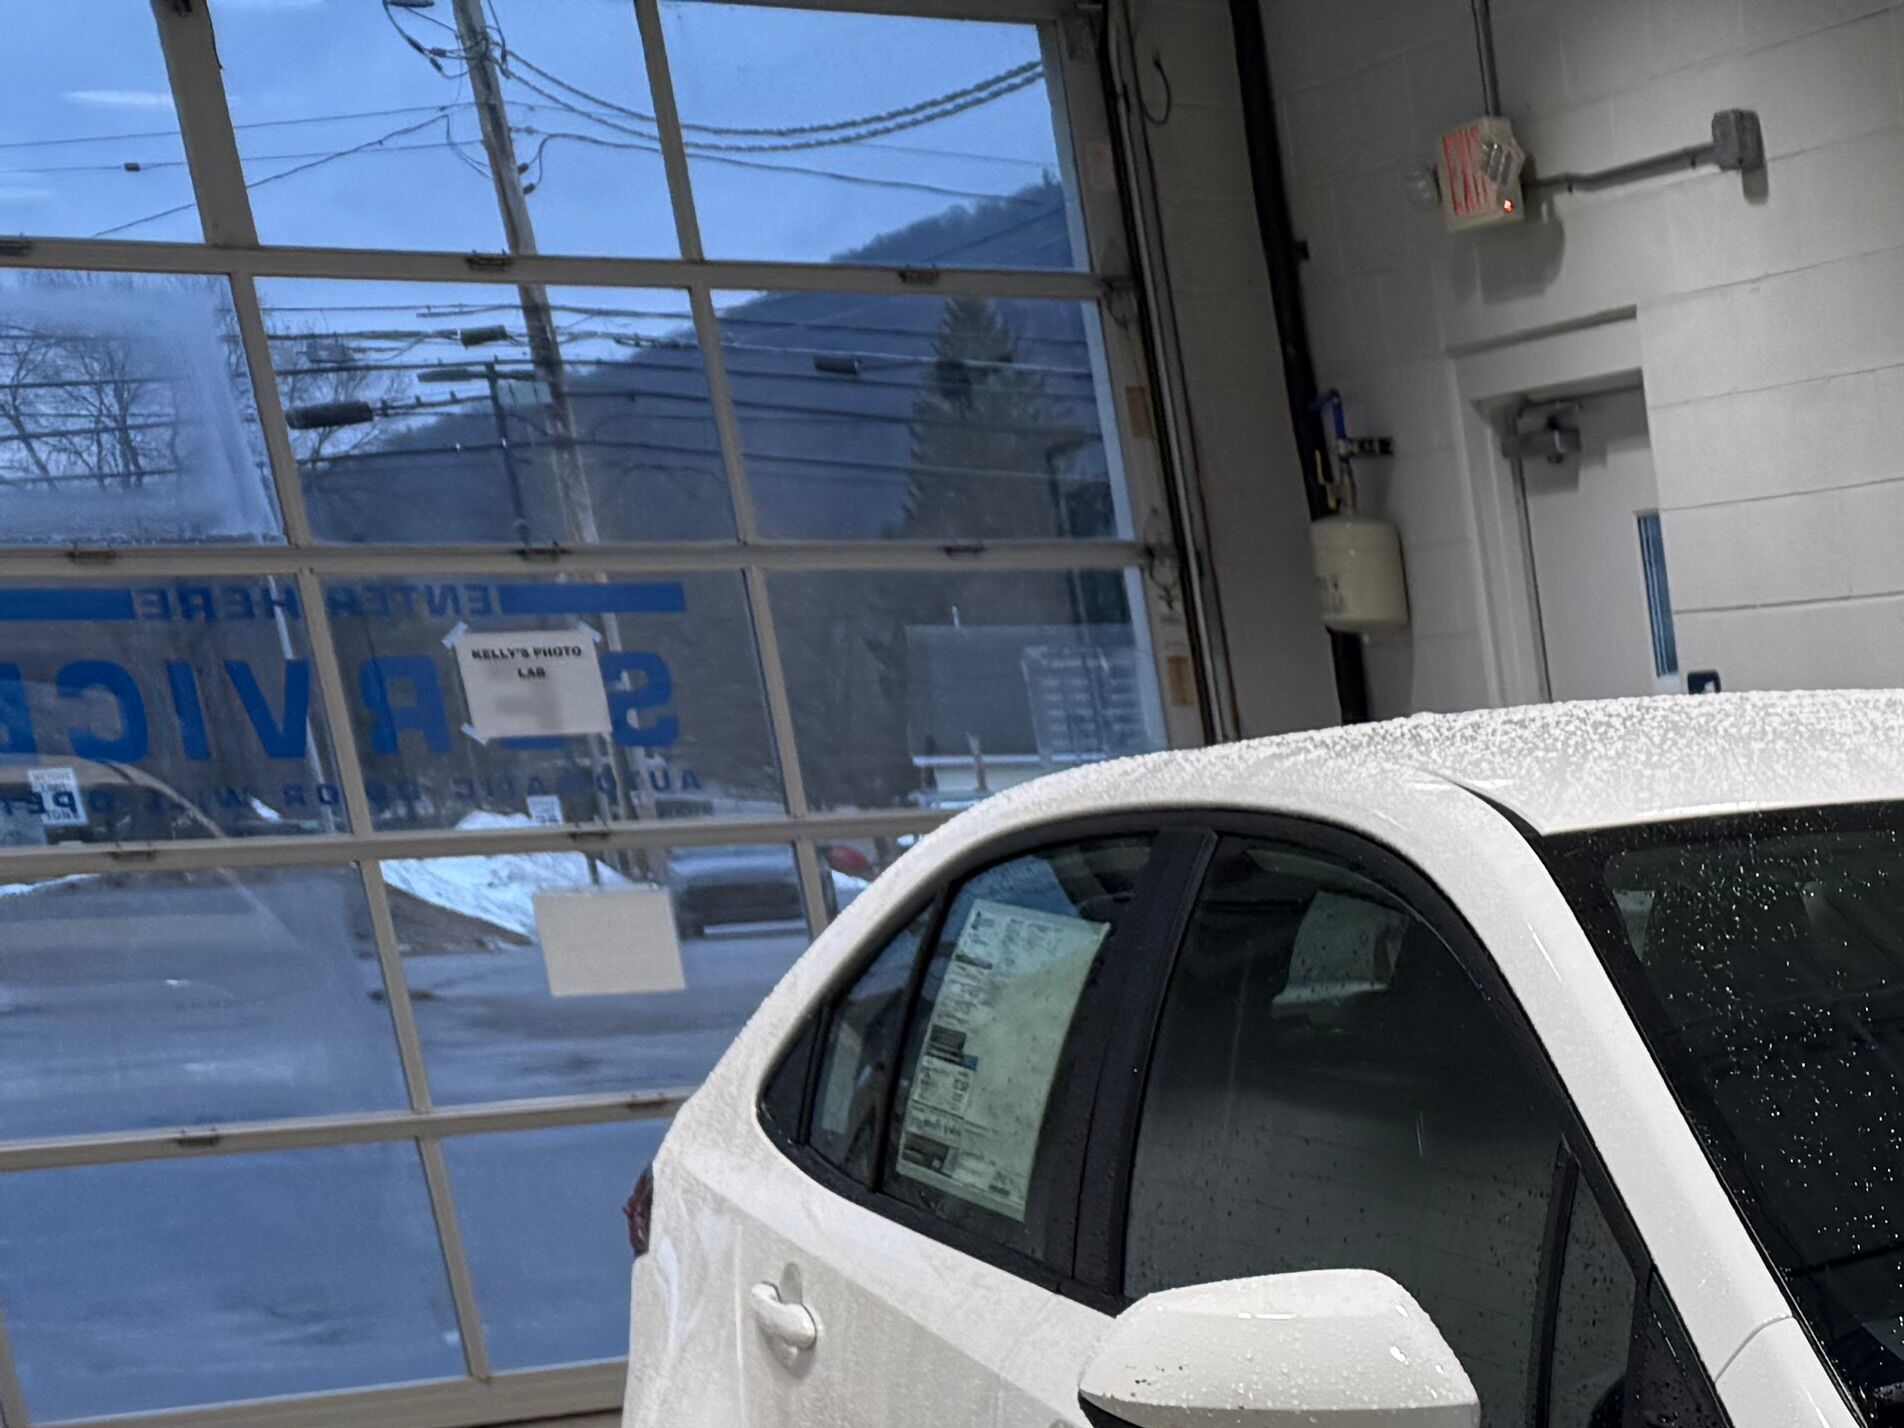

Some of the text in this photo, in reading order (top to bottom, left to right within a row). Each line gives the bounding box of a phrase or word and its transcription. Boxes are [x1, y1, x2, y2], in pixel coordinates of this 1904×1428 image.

[471, 645, 582, 660] KELLY'S PHOTO
[517, 667, 546, 678] LAB
